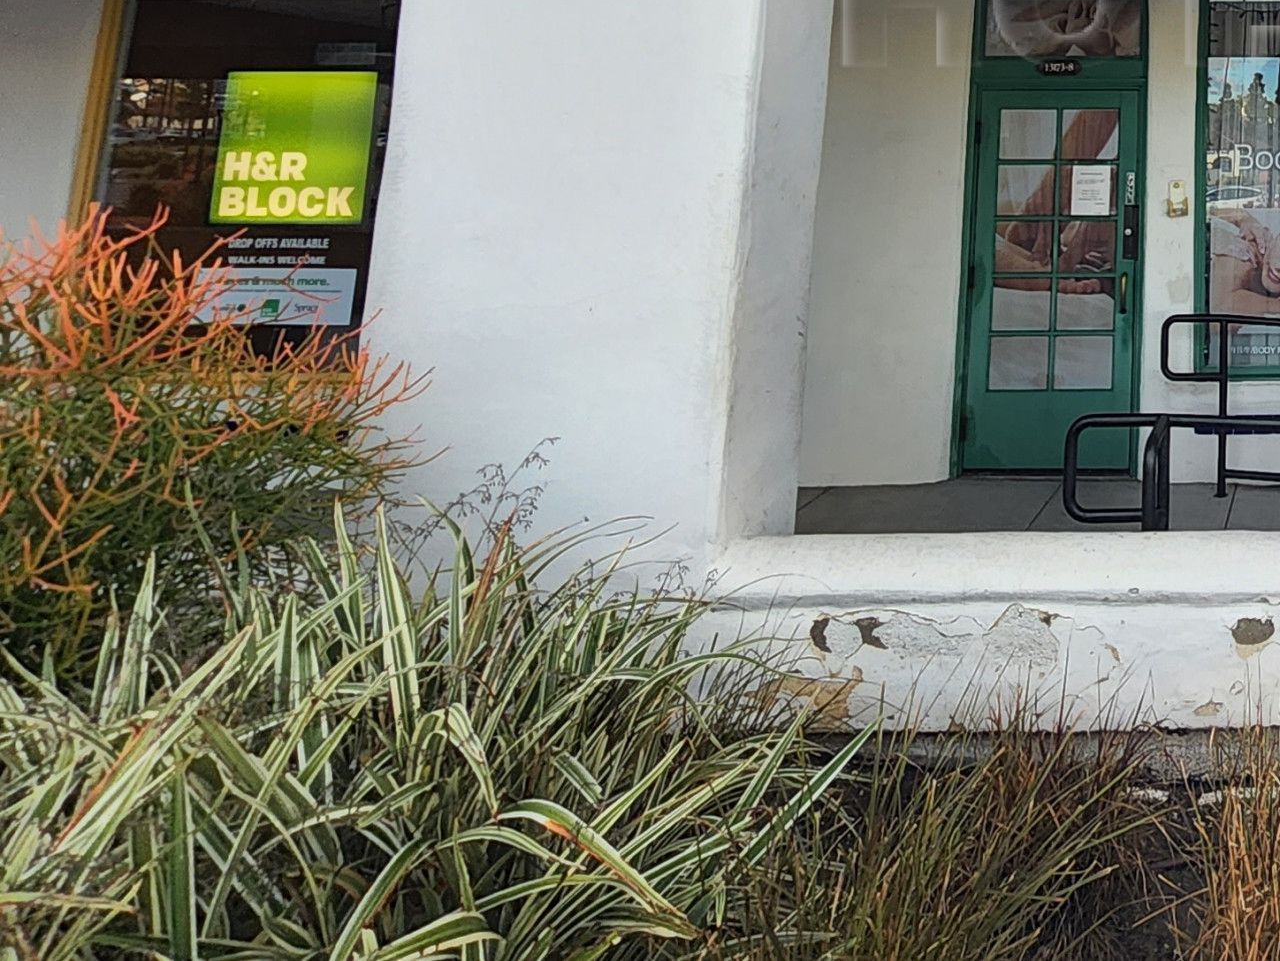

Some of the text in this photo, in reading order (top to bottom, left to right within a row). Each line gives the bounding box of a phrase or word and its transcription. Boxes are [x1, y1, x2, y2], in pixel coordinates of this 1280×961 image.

[222, 151, 308, 182] H&R
[217, 186, 355, 217] BLOCK
[279, 238, 330, 249] AVAILABLE
